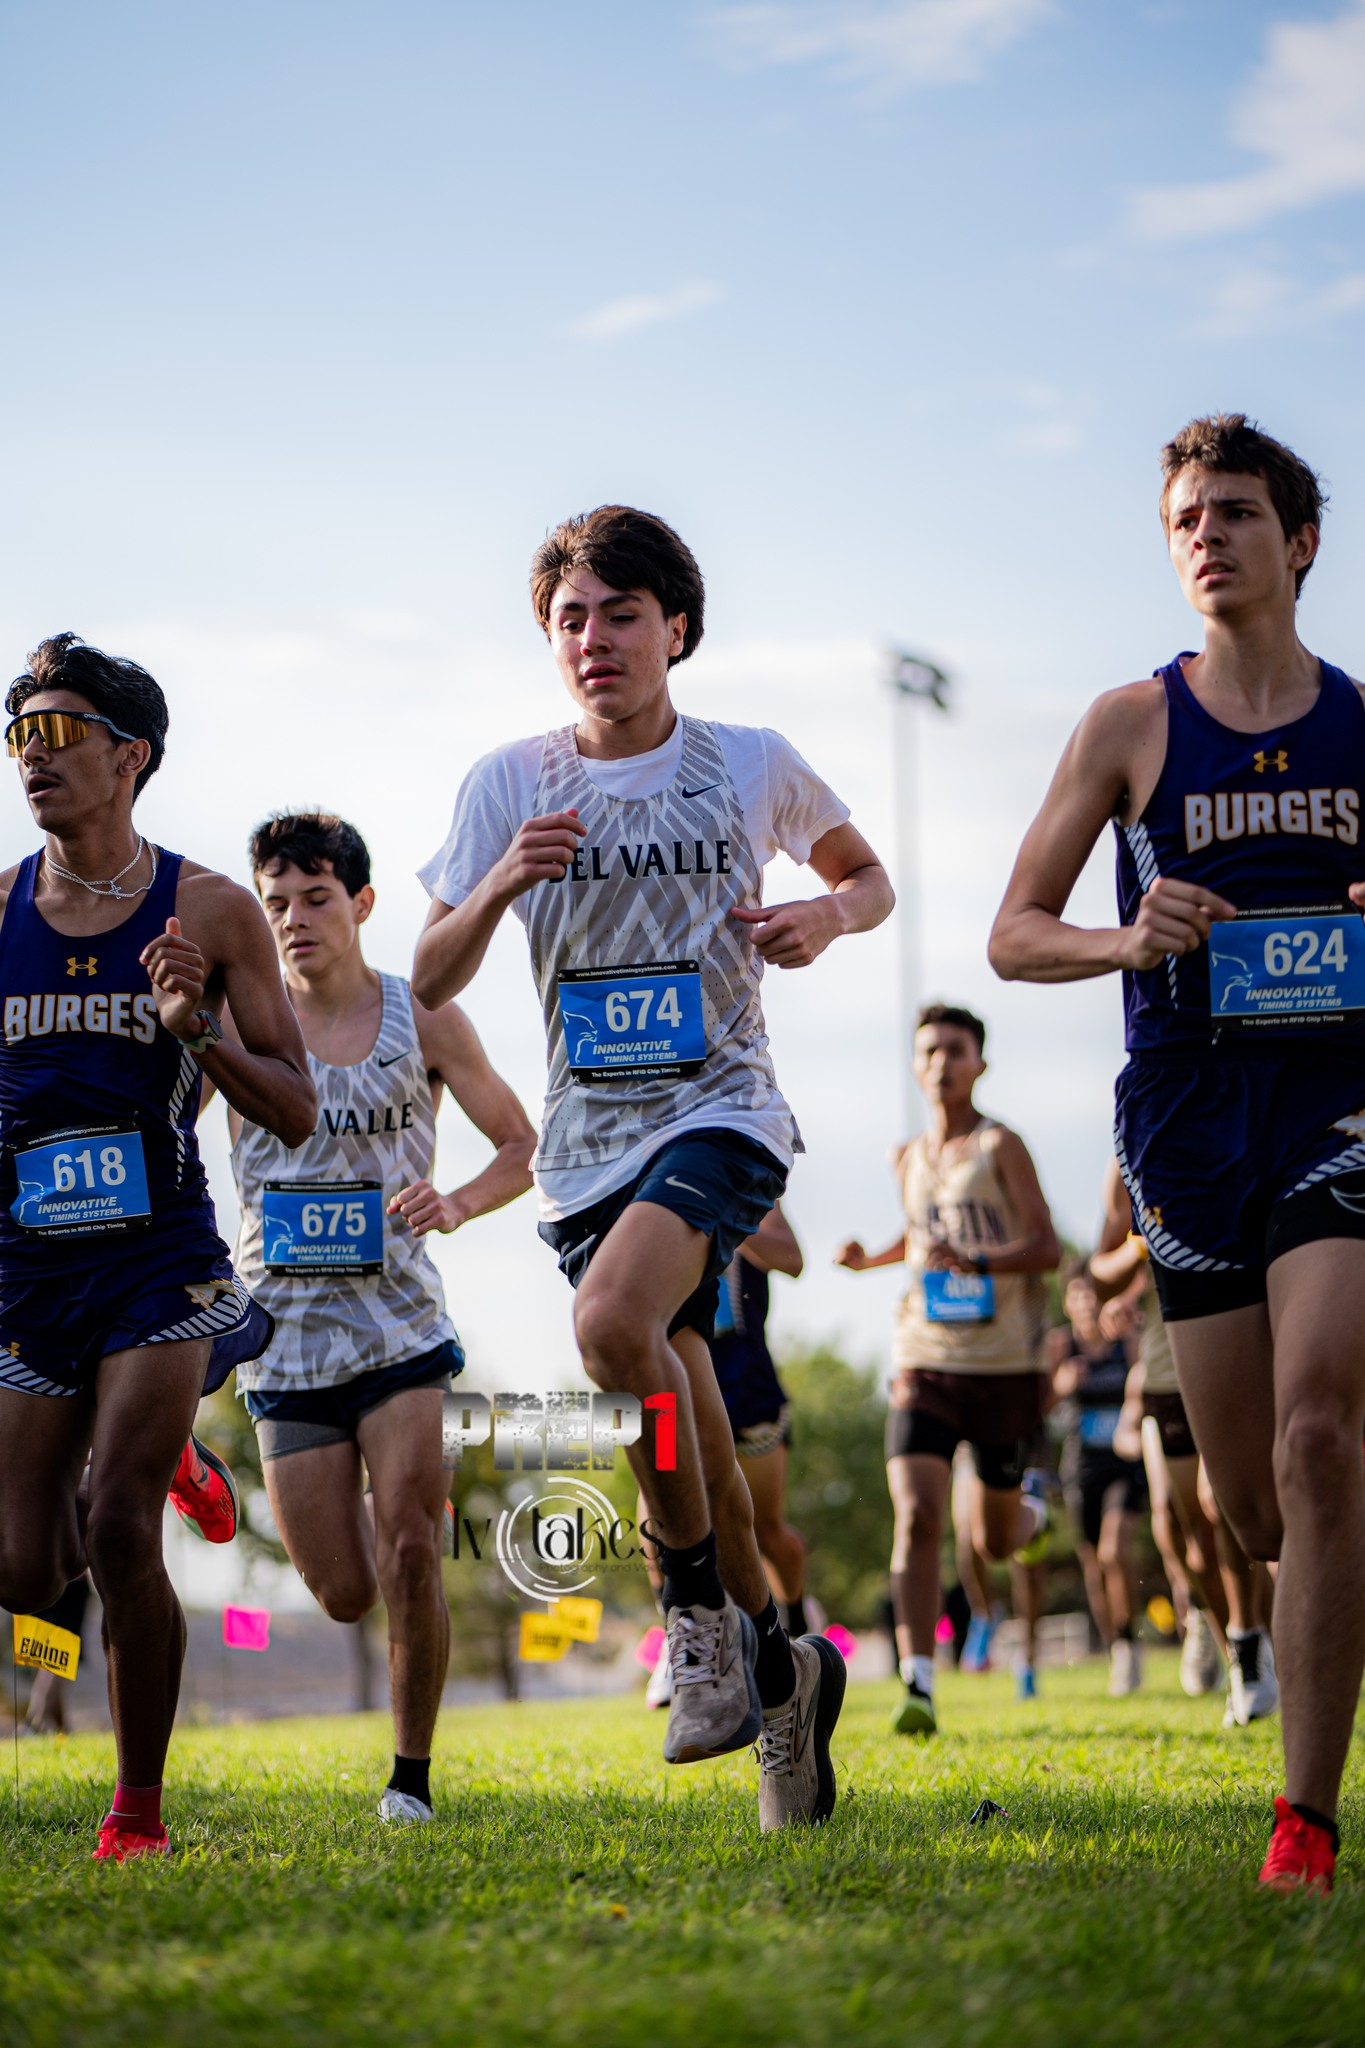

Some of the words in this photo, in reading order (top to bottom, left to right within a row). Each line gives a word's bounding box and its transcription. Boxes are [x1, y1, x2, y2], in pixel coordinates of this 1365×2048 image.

[1184, 788, 1359, 854] BURGES
[618, 839, 732, 880] VALLE
[1263, 928, 1348, 977] 624
[605, 986, 683, 1033] 674
[1245, 985, 1337, 1001] INNOVATIVE
[1257, 1000, 1293, 1011] TIMING
[1295, 997, 1342, 1009] SYSTEMS
[3, 993, 157, 1046] BURGES
[592, 1040, 672, 1055] INNOVATIVE
[603, 1053, 635, 1064] TIMING
[637, 1051, 678, 1062] SYSTEMS
[323, 1102, 413, 1138] VALLE
[53, 1146, 126, 1193] 618
[37, 1196, 117, 1214] INNOVATIVE
[49, 1212, 80, 1222] TIMING
[82, 1207, 124, 1219] SYSTEMS
[301, 1202, 367, 1238] 675
[287, 1244, 357, 1255] INNOVATIVE
